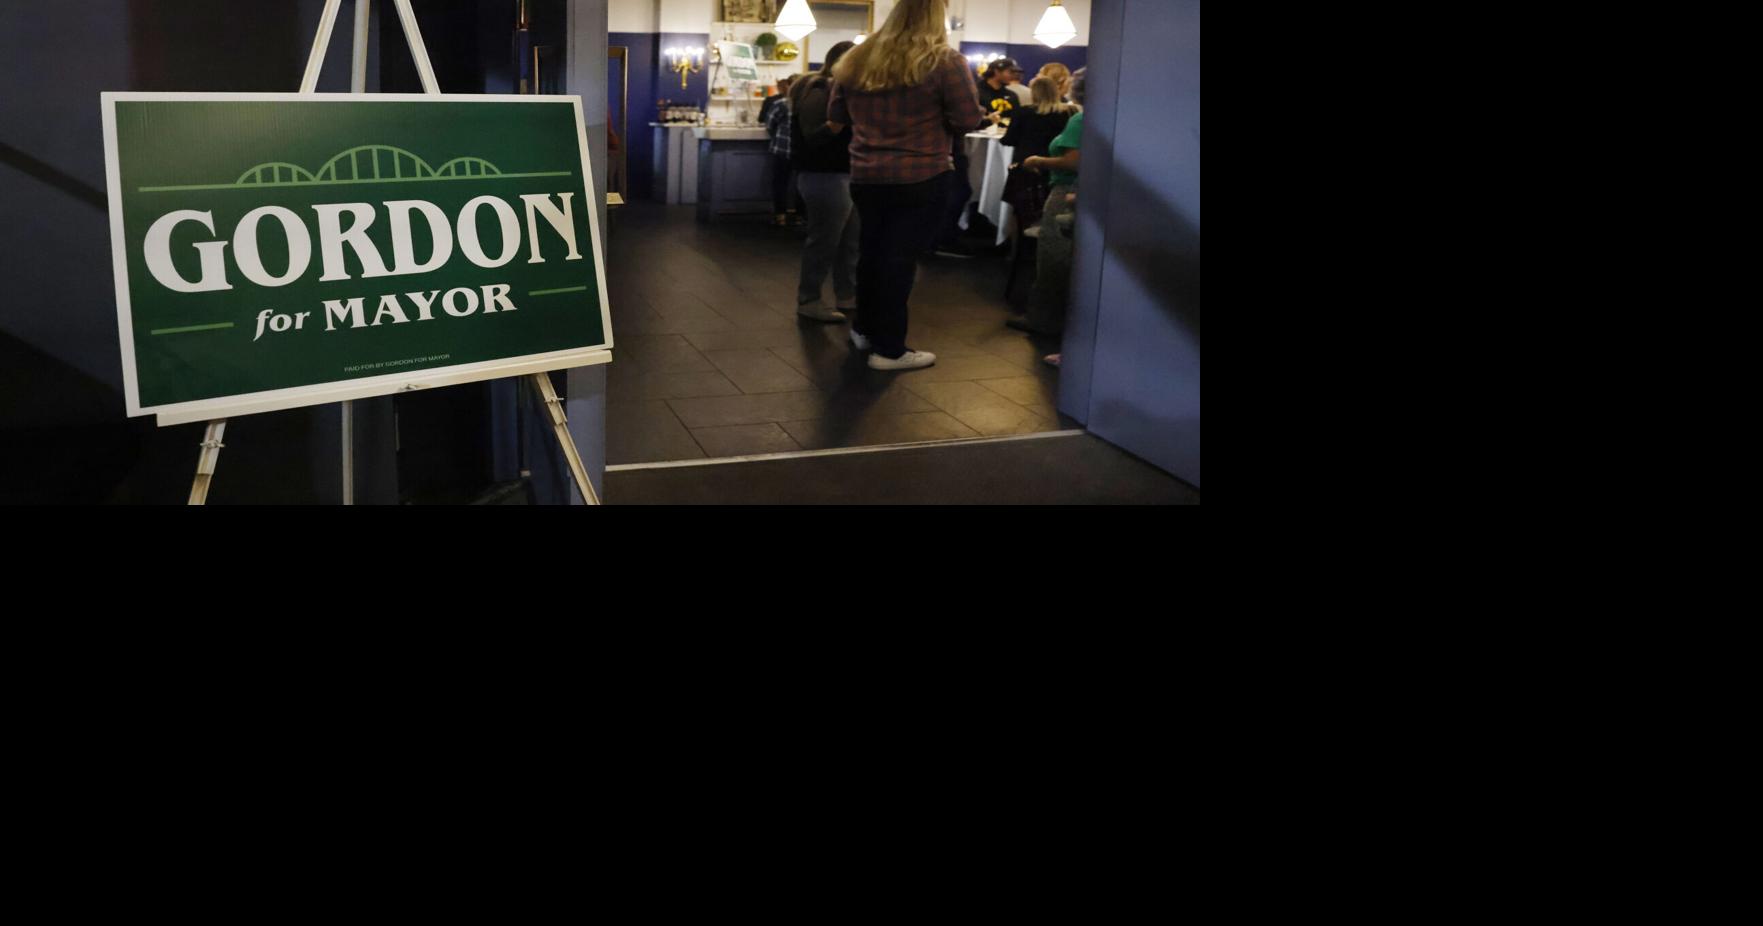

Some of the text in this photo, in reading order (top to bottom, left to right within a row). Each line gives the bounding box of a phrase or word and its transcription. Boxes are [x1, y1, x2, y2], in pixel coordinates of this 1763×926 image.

[143, 192, 583, 293] GORDON
[252, 283, 518, 341] for MAYOR
[385, 359, 414, 367] GORDON
[428, 353, 450, 361] MAYOR
